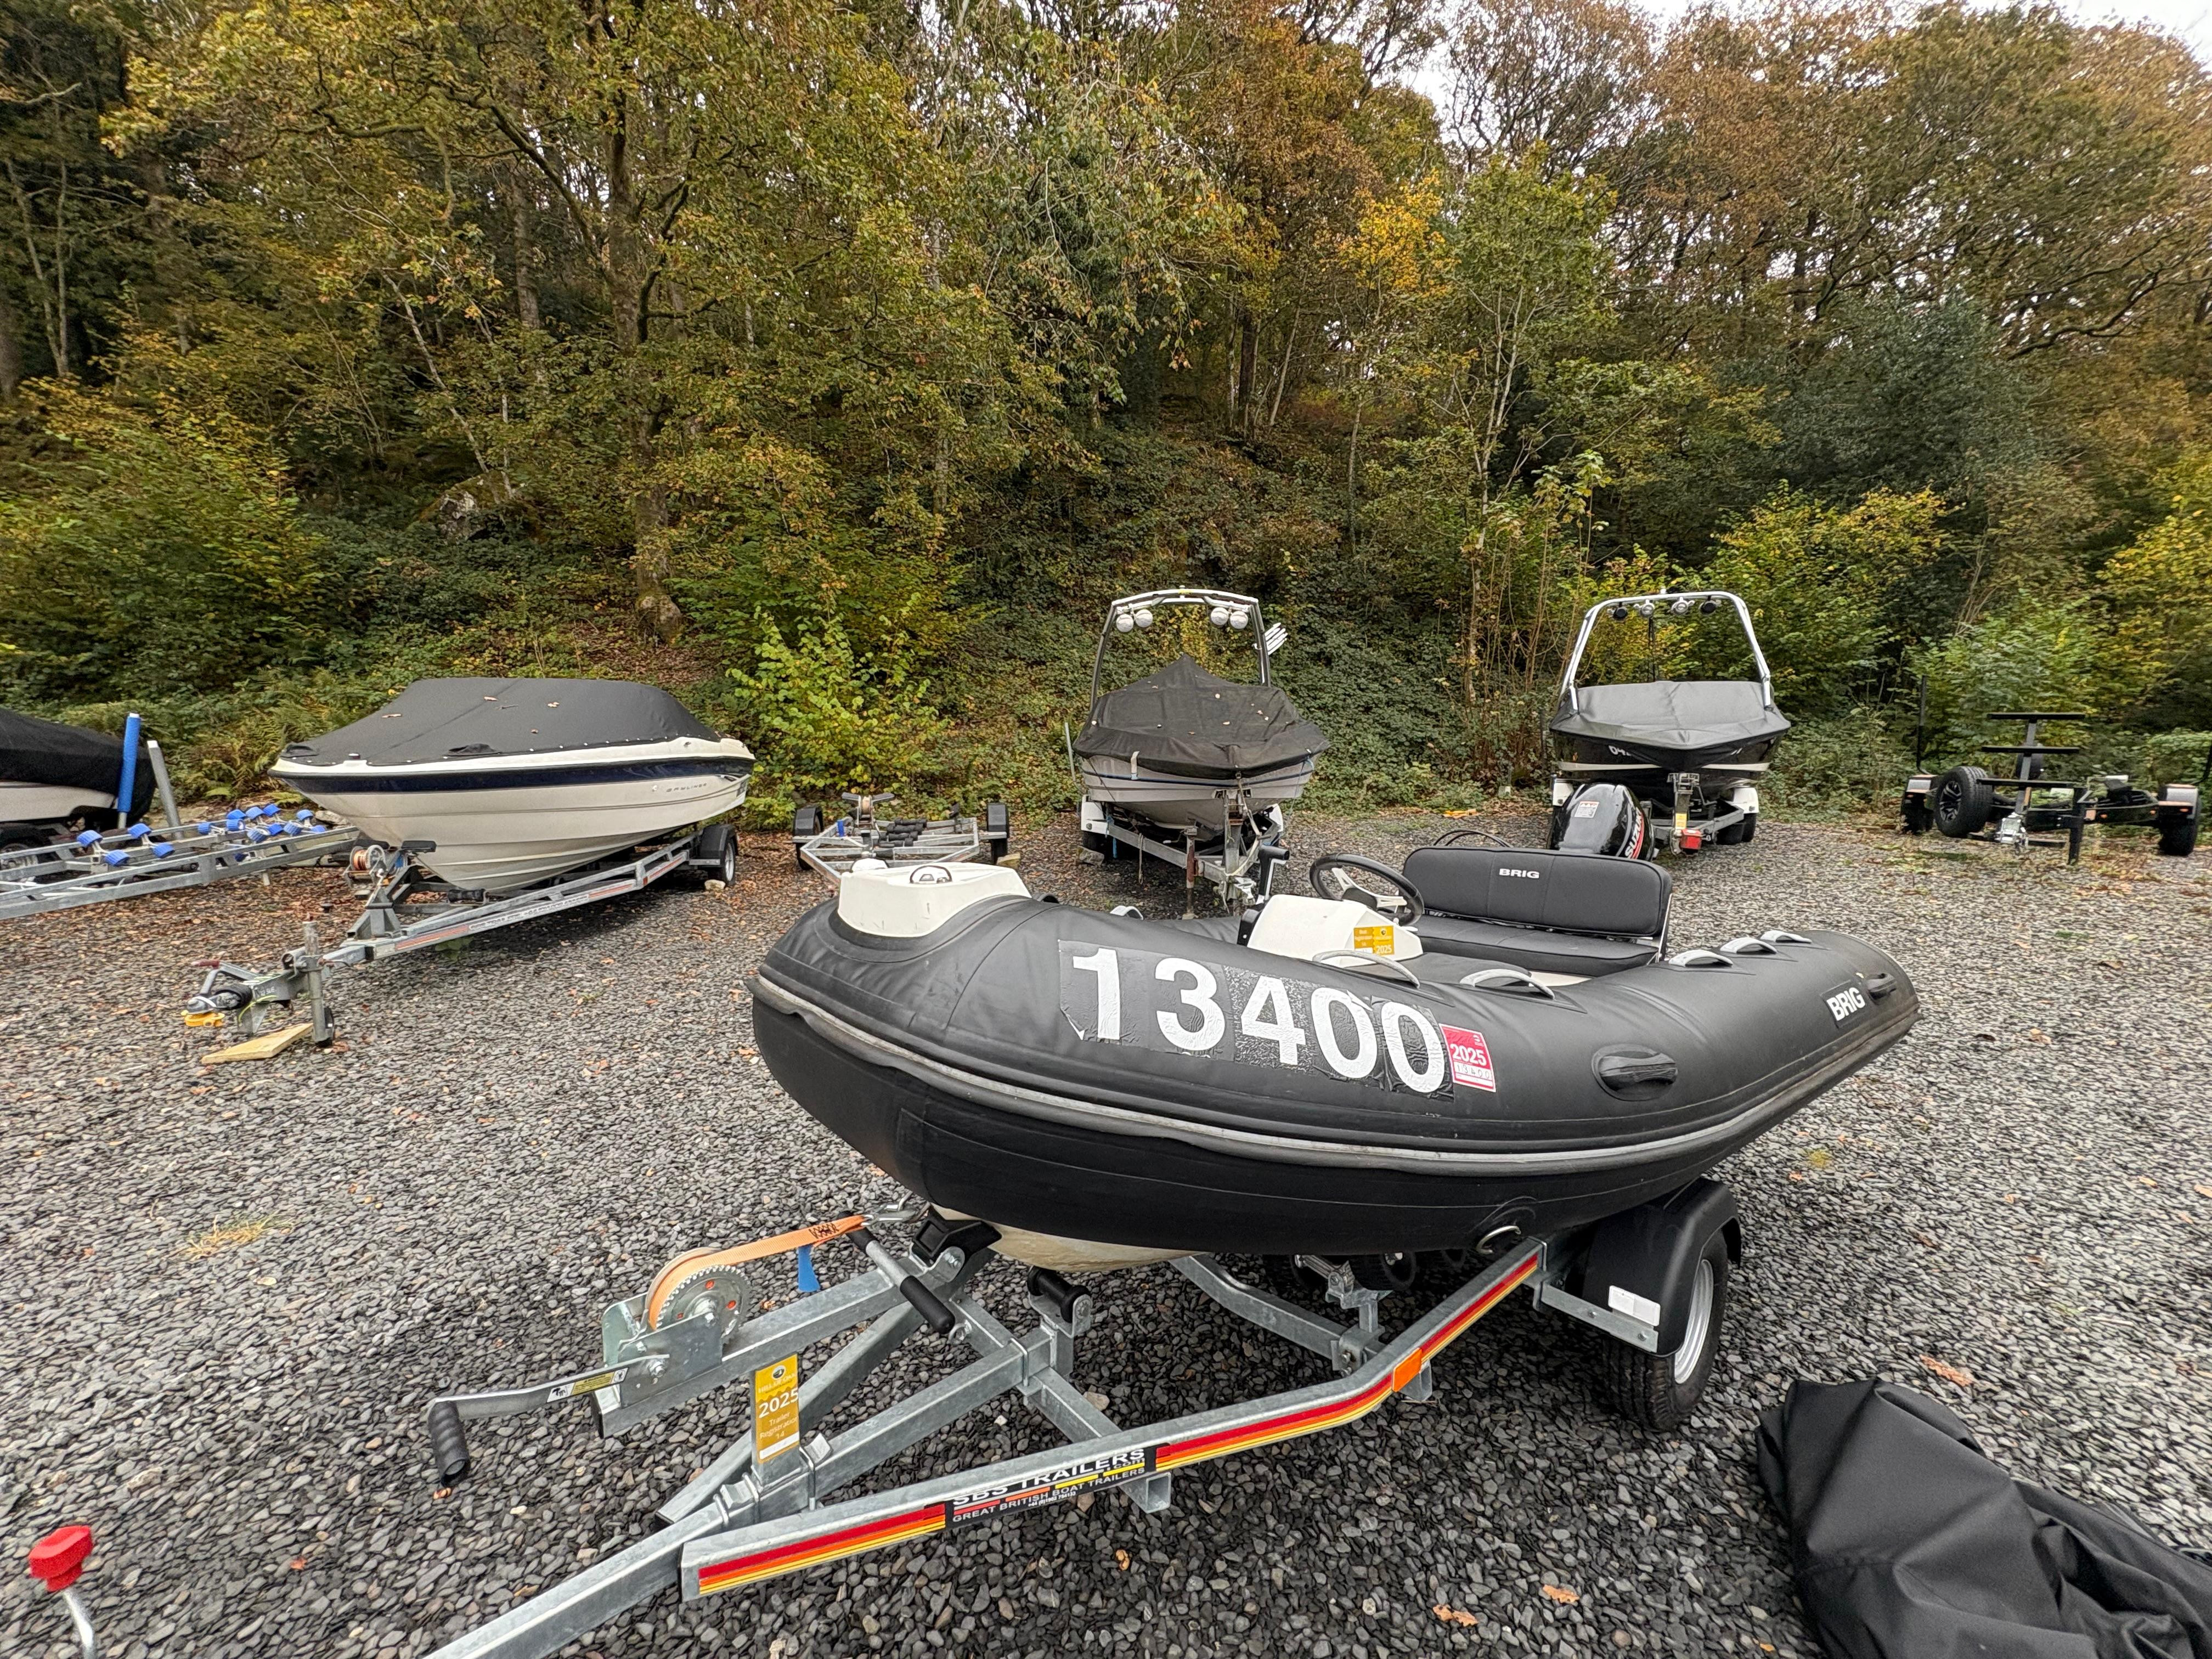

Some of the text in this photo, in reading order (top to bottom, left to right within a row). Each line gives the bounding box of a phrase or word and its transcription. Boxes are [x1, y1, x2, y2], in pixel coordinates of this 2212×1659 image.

[1499, 868, 1540, 879] BRIG
[1375, 945, 1392, 953] 2025
[1073, 947, 1446, 1093] 13400
[1826, 987, 1866, 1021] BRIG
[1449, 1043, 1487, 1066] 2025
[759, 1386, 799, 1419] 2025
[769, 1412, 790, 1426] Trailer
[1022, 1448, 1144, 1488] TRAILERS
[952, 1467, 1146, 1522] GREAT BRITISH BOAT TRAILERS
